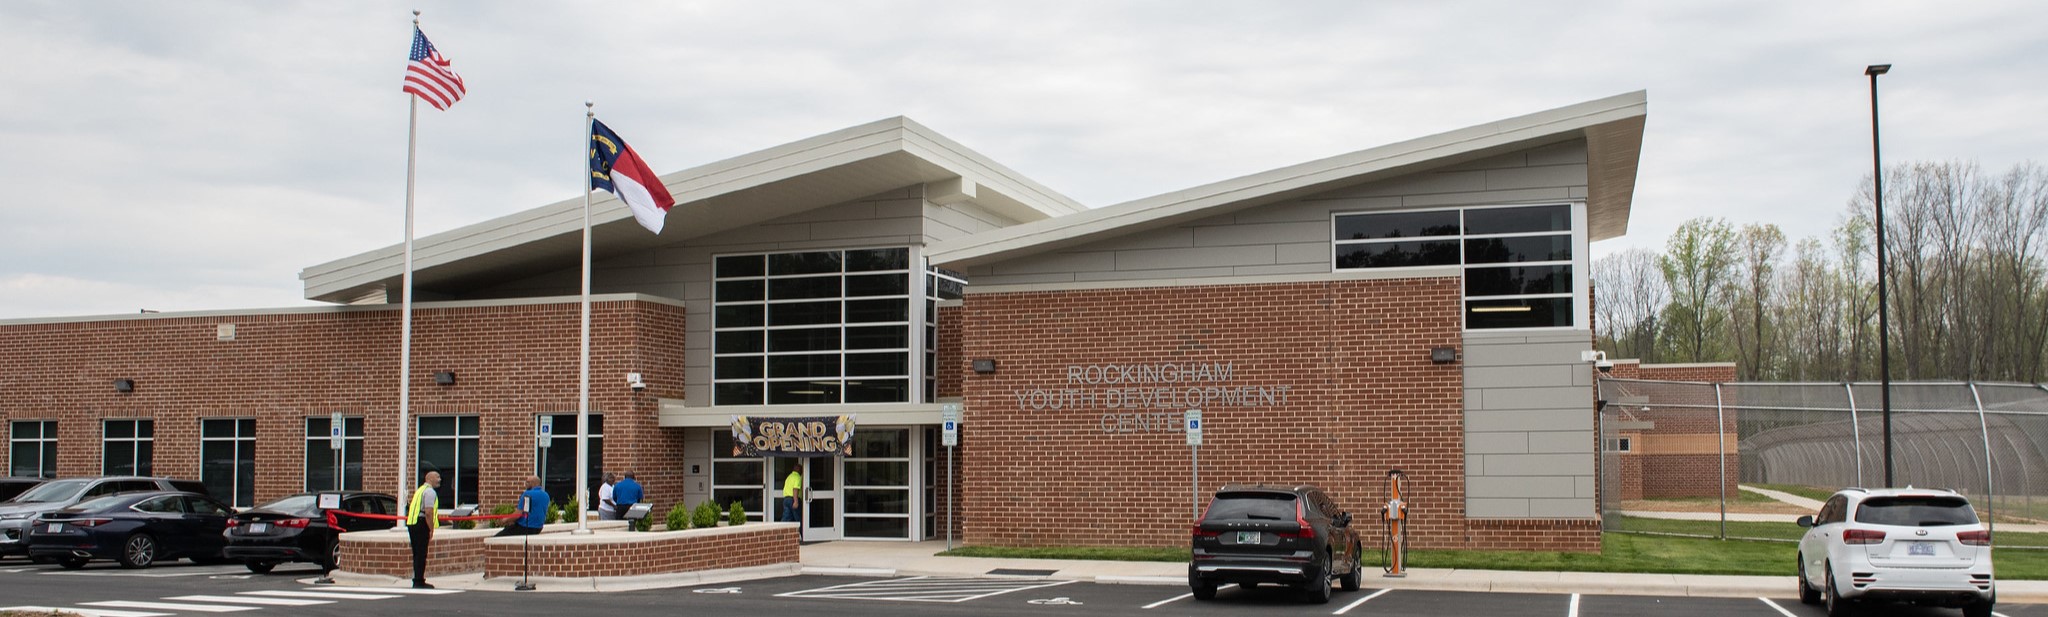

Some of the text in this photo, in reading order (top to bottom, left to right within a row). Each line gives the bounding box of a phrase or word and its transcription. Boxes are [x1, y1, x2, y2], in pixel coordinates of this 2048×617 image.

[1067, 362, 1233, 385] ROCKINGHAM
[1013, 385, 1291, 410] YOUTH DEVELOPMENT
[759, 421, 827, 437] GRAND
[1101, 412, 1187, 434] CENTE
[753, 435, 837, 452] OPENING
